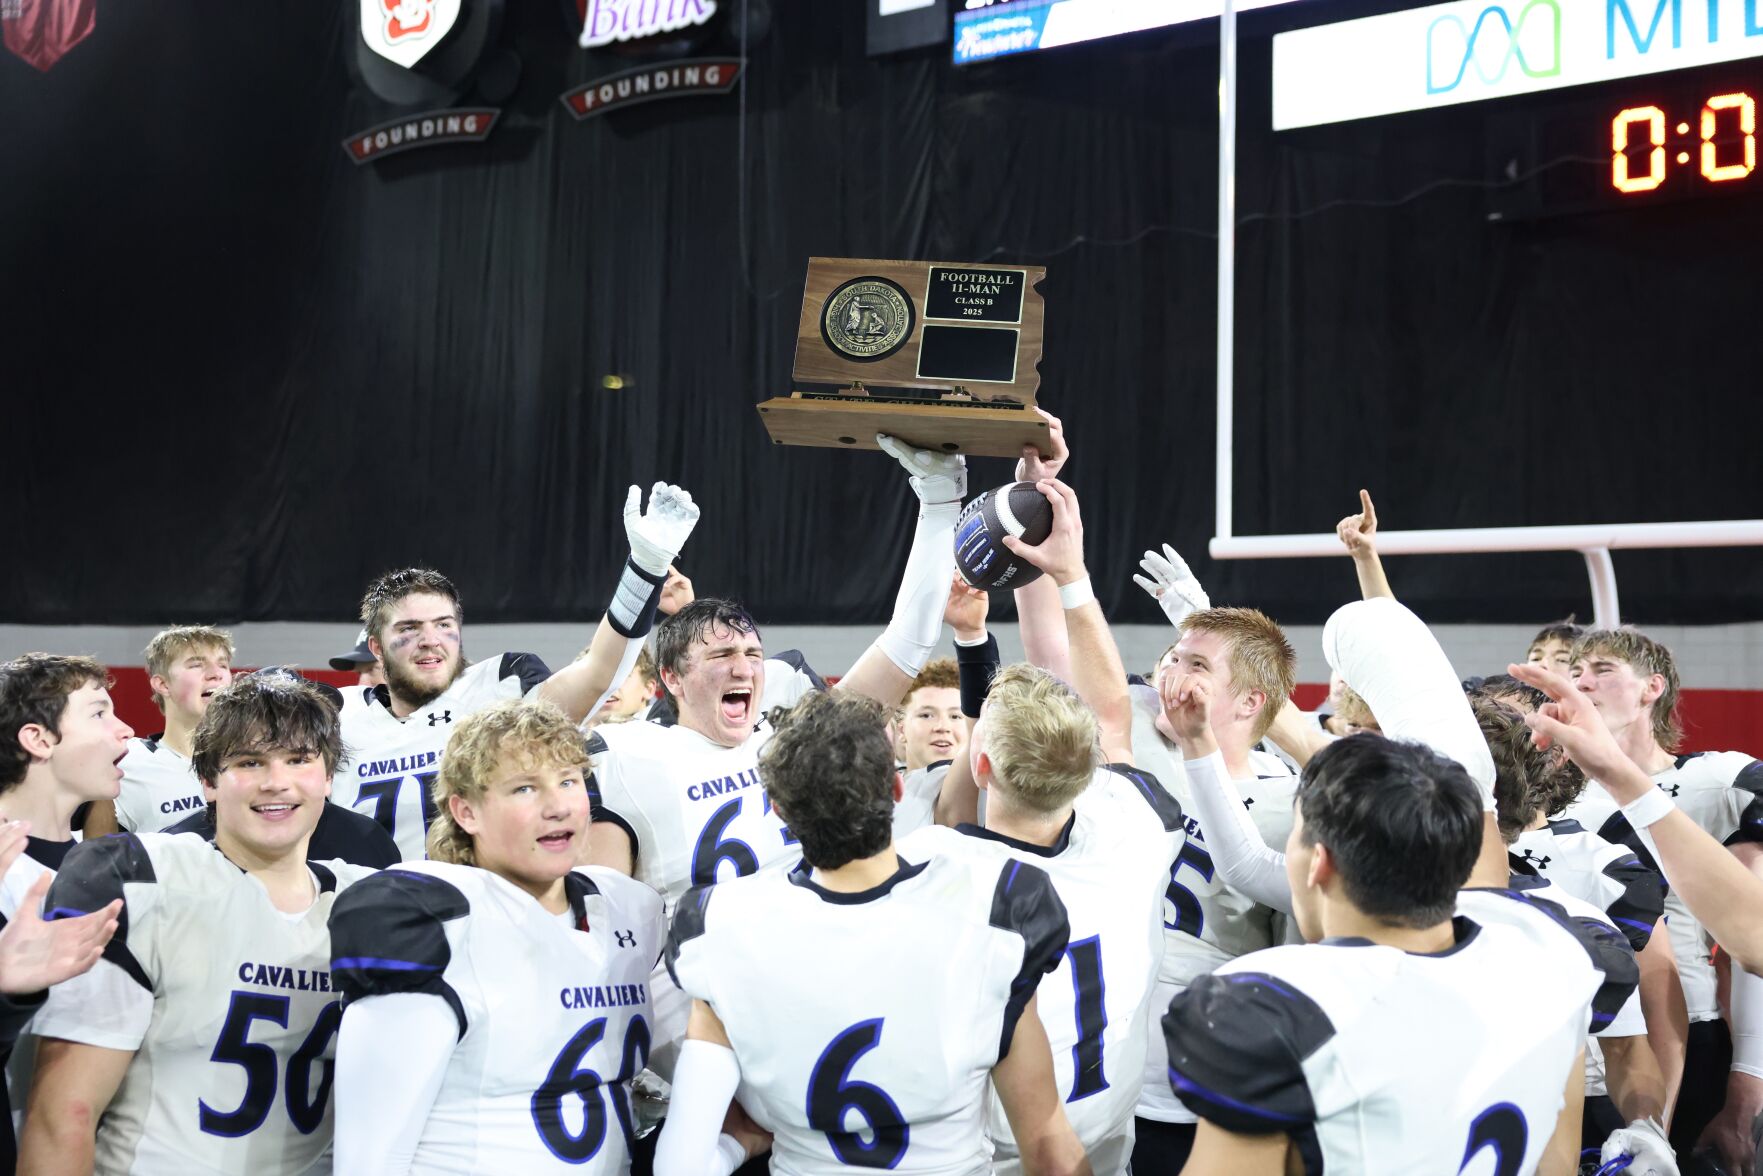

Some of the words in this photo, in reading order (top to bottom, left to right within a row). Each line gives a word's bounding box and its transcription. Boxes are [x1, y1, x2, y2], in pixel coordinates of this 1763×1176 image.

[584, 65, 720, 109] FOUNDING
[362, 114, 478, 154] FOUNDING
[940, 272, 1014, 285] FOOTBALL
[952, 283, 1001, 295] 11-MAN
[869, 285, 897, 303] DAKOTA
[955, 296, 985, 306] CLASS
[987, 298, 994, 306] B
[962, 307, 983, 316] 2025
[238, 962, 338, 993] CAVALIE
[559, 983, 646, 1010] CAVALIERS
[806, 1016, 910, 1171] 6
